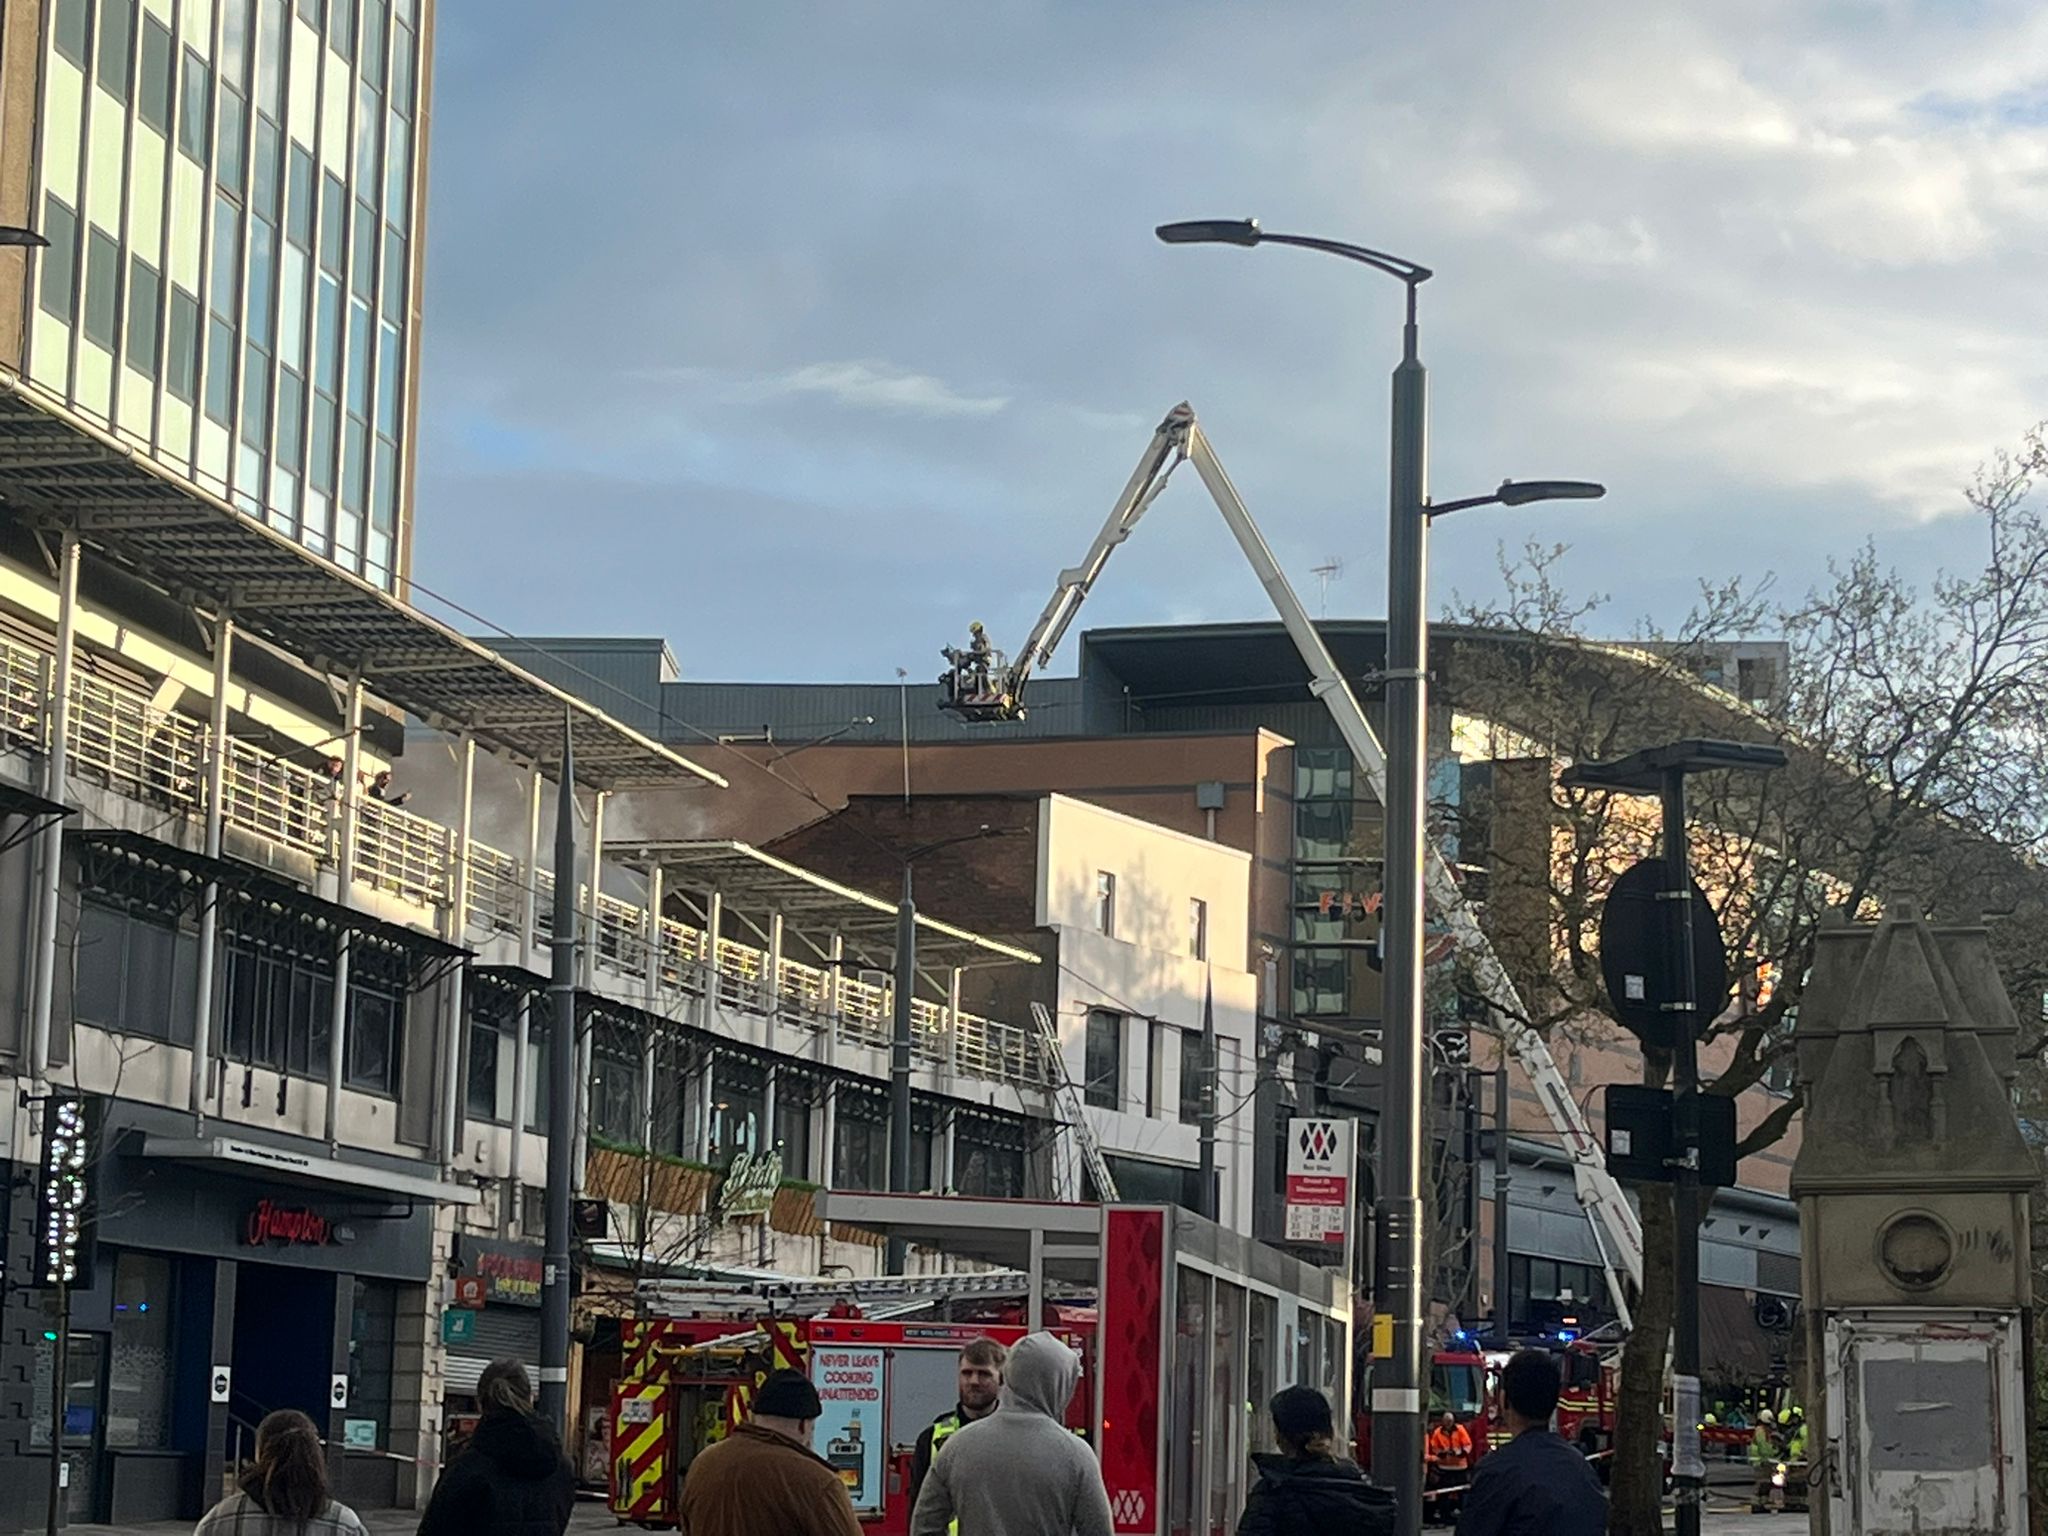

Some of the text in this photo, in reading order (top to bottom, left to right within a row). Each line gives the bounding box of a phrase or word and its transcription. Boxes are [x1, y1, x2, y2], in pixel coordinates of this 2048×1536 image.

[1319, 891, 1383, 914] FIV
[820, 1354, 880, 1368] NEVER LEAVE
[824, 1371, 873, 1384] COOKING
